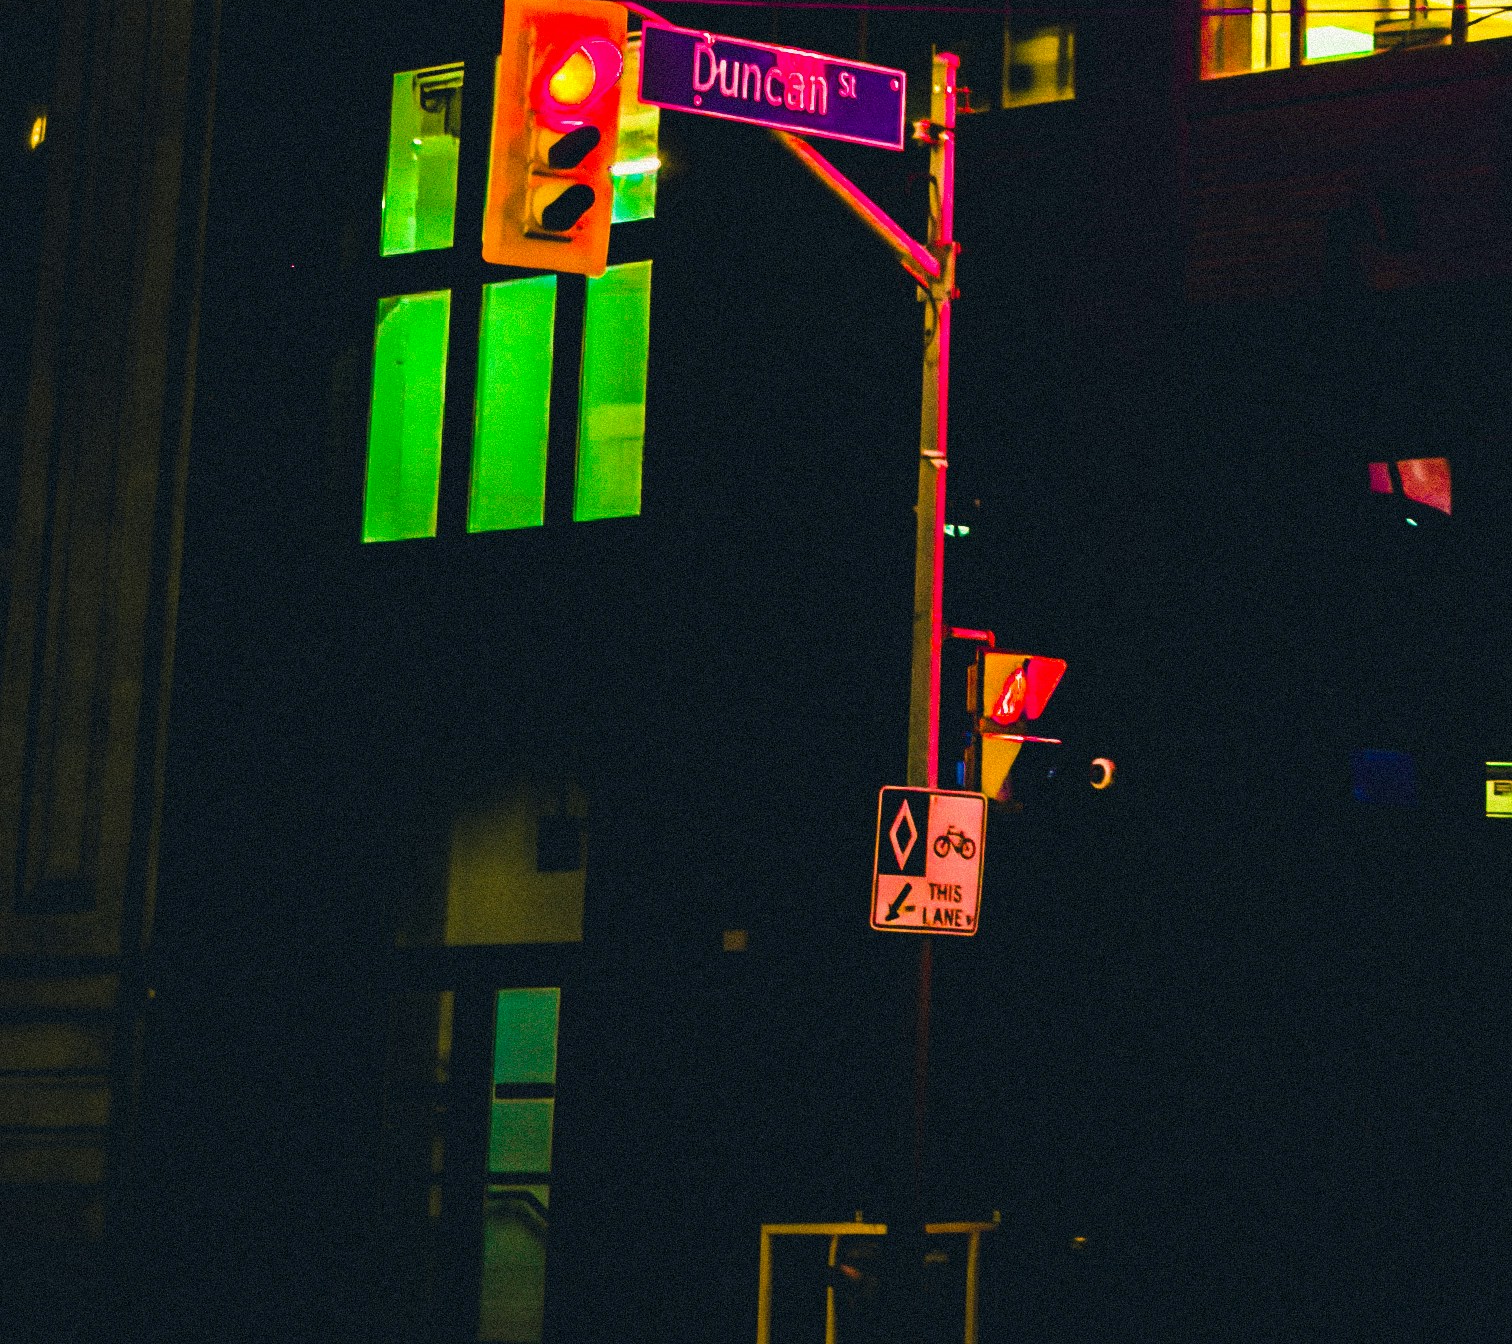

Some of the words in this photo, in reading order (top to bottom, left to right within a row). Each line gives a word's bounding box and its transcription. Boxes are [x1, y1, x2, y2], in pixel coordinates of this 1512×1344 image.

[692, 43, 828, 116] Duncan
[838, 69, 857, 100] St
[929, 882, 962, 904] THIS
[922, 906, 963, 928] LANE
